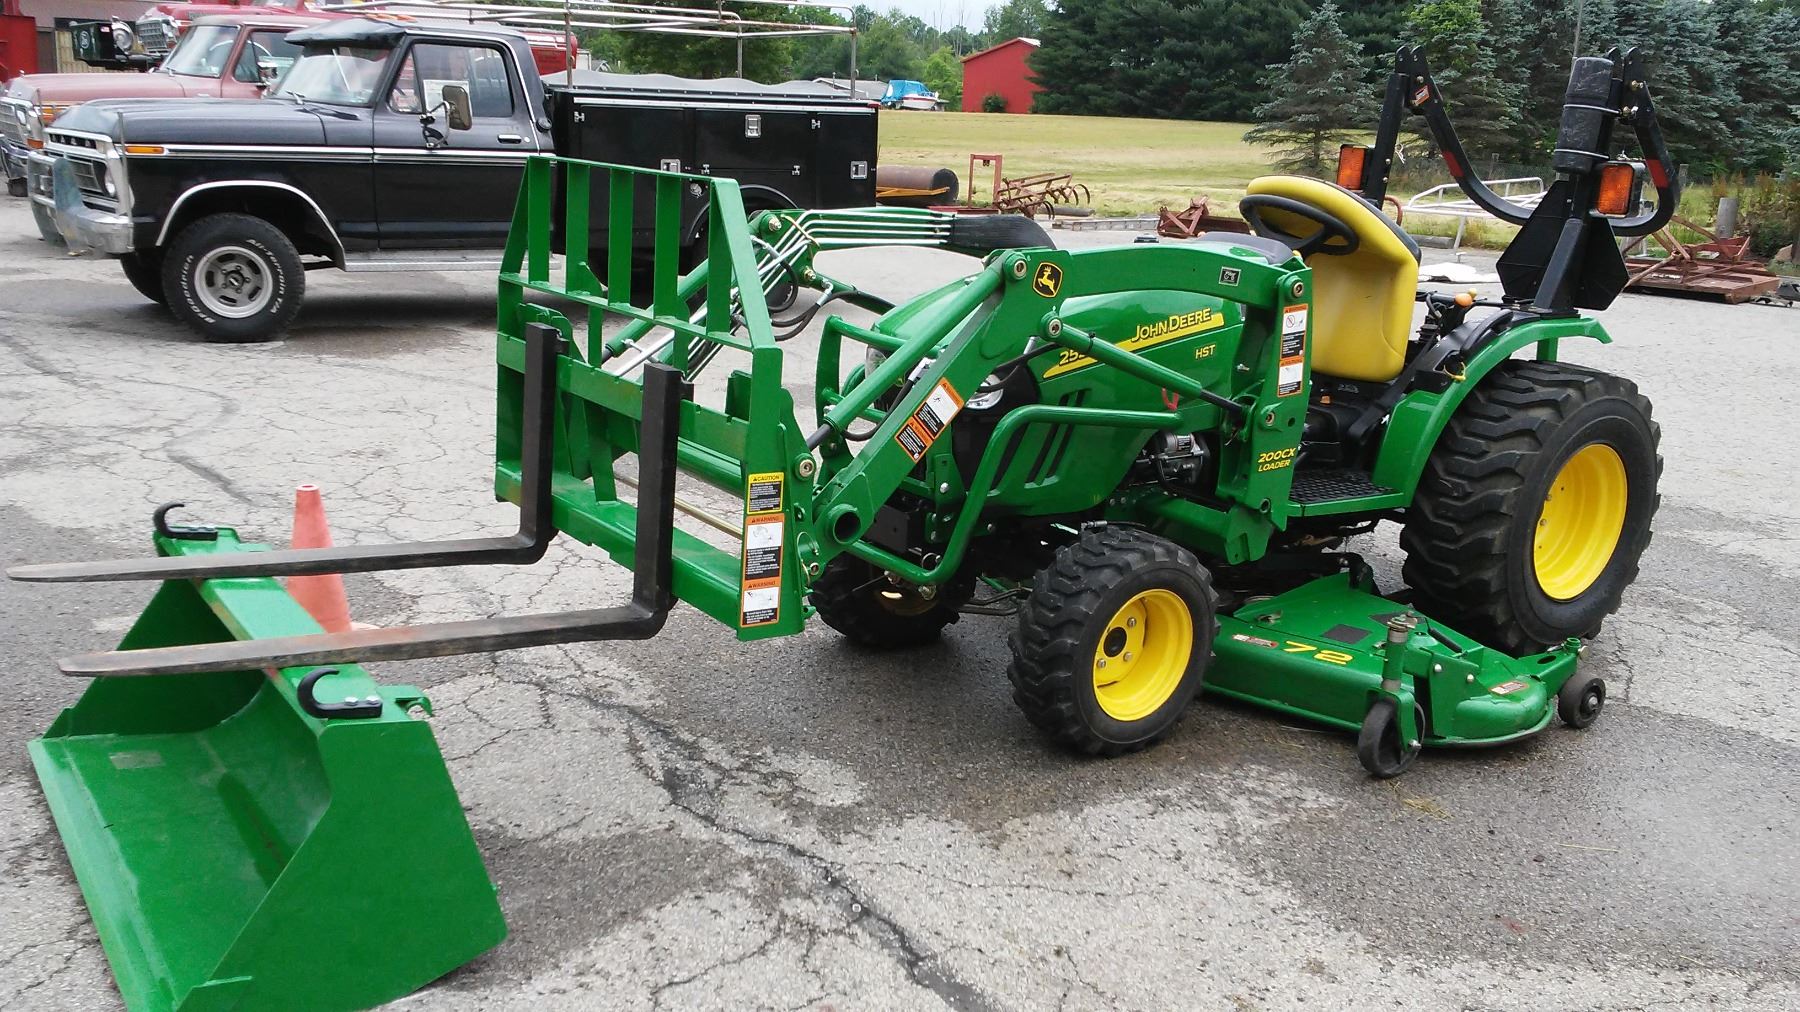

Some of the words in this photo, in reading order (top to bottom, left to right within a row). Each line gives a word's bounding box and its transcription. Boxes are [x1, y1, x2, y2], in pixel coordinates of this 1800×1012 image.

[1131, 320, 1168, 342] JOHN
[1168, 307, 1211, 331] DEERE
[1059, 349, 1086, 366] 25
[1195, 343, 1216, 359] HST
[1257, 447, 1297, 463] 200CX
[1258, 459, 1291, 472] LOADER
[756, 474, 780, 482] CAUTION
[755, 515, 780, 523] WARNING
[752, 580, 776, 588] WARNING
[1283, 639, 1354, 666] 72
